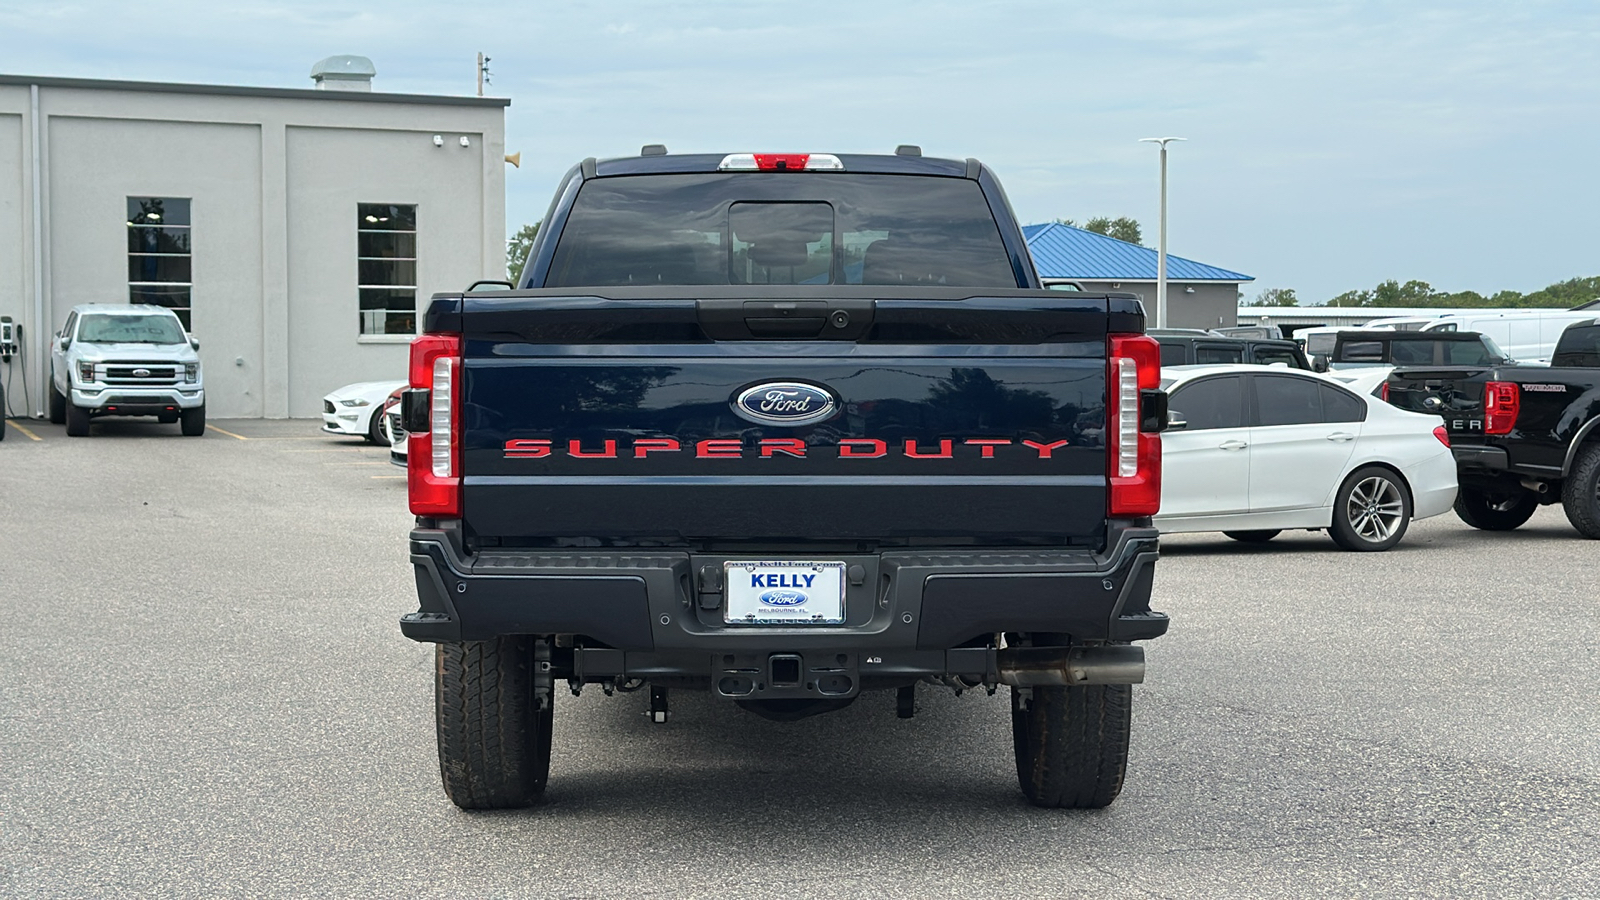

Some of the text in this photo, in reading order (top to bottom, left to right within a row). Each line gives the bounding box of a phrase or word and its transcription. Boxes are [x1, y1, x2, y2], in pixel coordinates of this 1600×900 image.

[760, 390, 811, 411] Ford
[503, 438, 1069, 459] SUPER DUTY
[751, 574, 816, 588] KELLY
[768, 591, 798, 604] Ford
